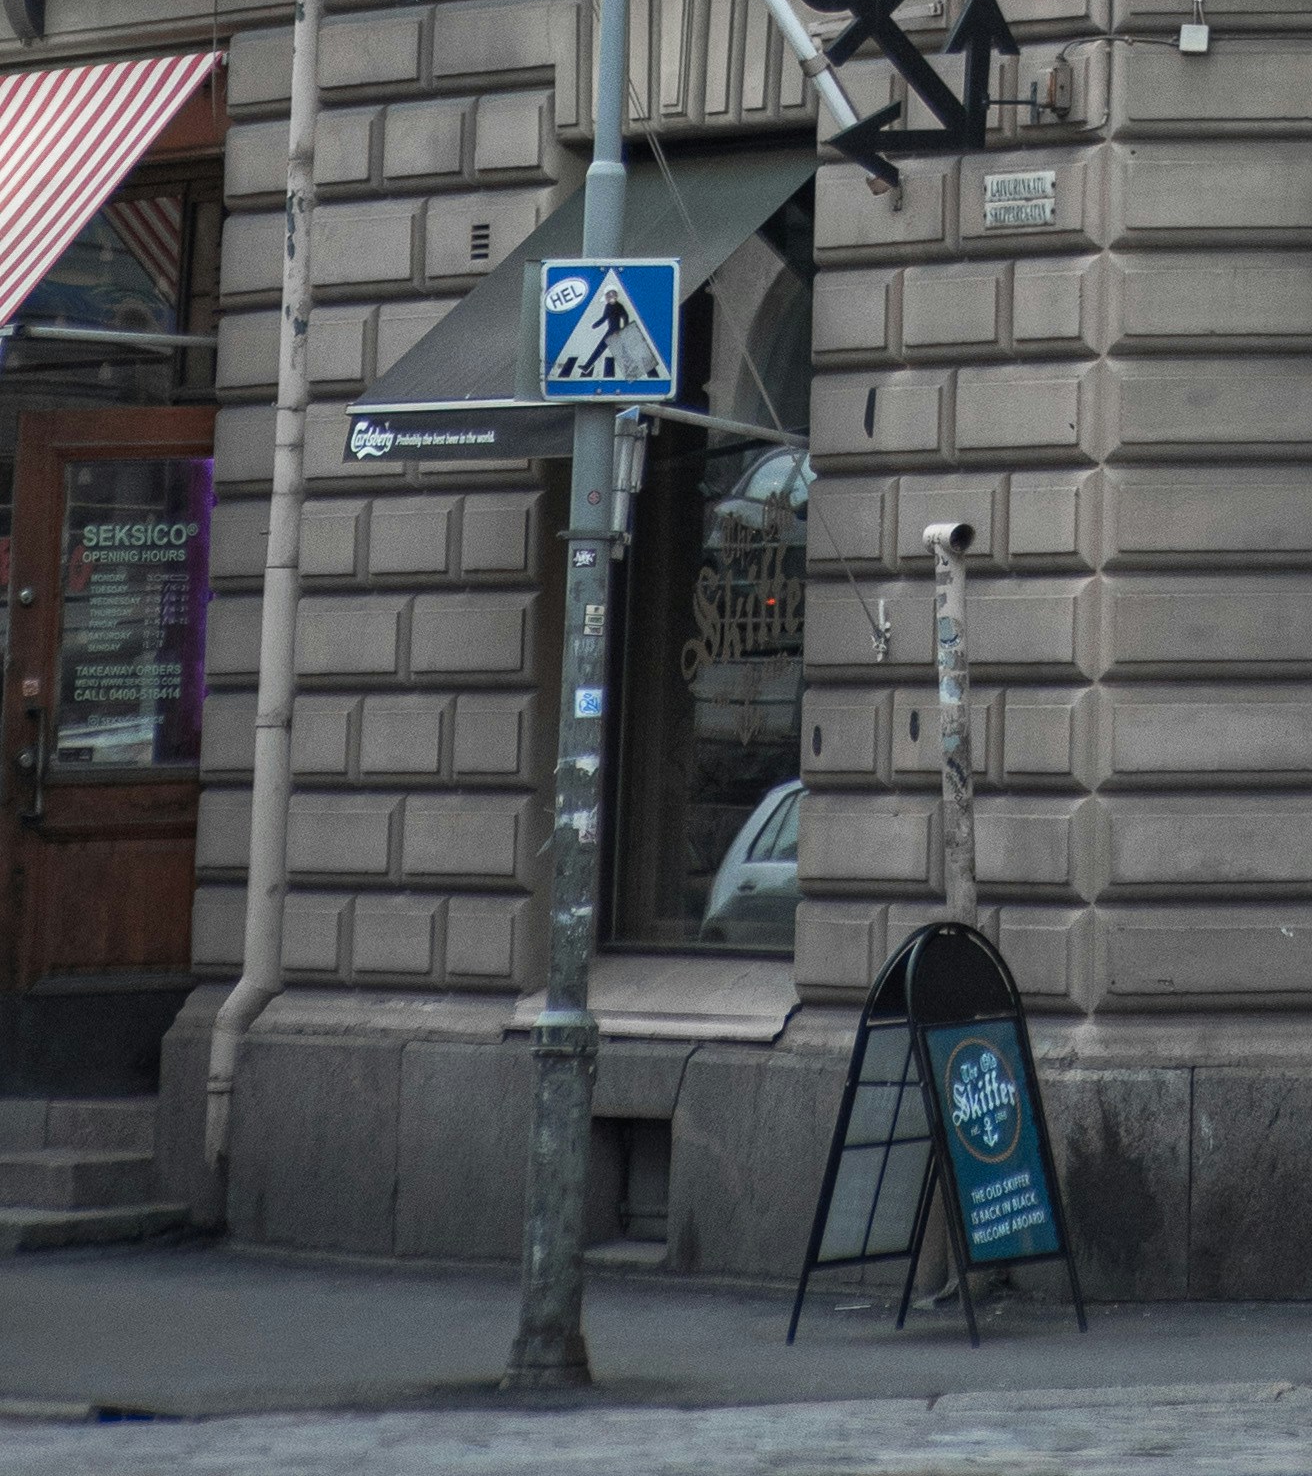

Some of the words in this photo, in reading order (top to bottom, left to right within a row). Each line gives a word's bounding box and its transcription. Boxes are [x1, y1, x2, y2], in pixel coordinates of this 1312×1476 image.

[550, 284, 583, 309] HEL
[350, 421, 395, 454] Carlsberg
[82, 550, 139, 564] OPENING
[141, 549, 186, 562] HOURS
[680, 544, 804, 681] Skiffe
[75, 665, 135, 677] TAKEAWAY
[136, 664, 183, 676] ORDERS
[74, 688, 107, 702] CALL
[952, 1070, 1015, 1127] Skiffer
[971, 1189, 986, 1204] THE
[986, 1183, 1003, 1200] OLD
[971, 1211, 980, 1225] IS
[980, 1204, 1002, 1223] BACK
[1012, 1192, 1038, 1212] BLACK
[972, 1221, 1011, 1245] WELCOME
